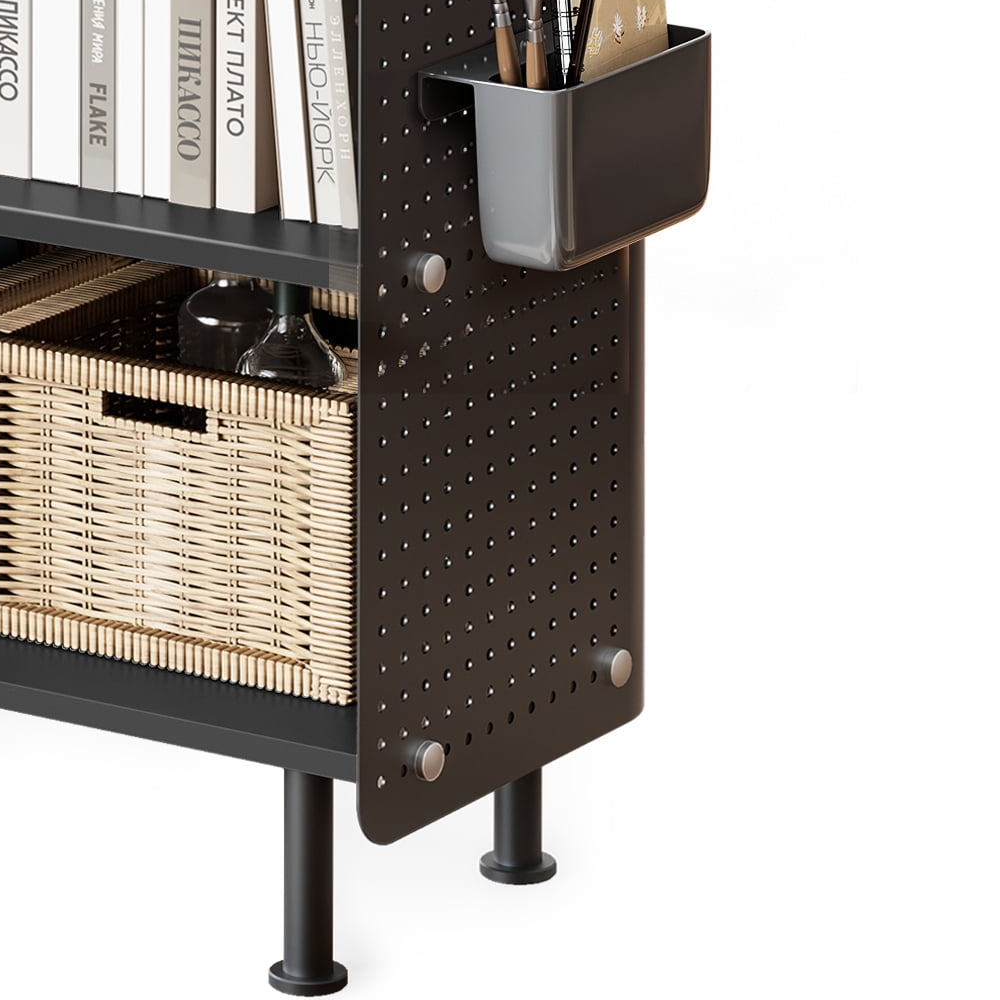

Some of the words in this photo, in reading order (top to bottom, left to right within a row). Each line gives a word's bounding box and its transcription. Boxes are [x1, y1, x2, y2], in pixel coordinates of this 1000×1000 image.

[90, 32, 105, 64] МИРА
[177, 16, 202, 161] ПИКАССО
[226, 49, 245, 136] ПЛАТО
[305, 21, 335, 185] НЬЮ-ЙОРК
[329, 15, 352, 162] ЭЛЛЕНХОРН
[88, 82, 108, 147] FLAKE
